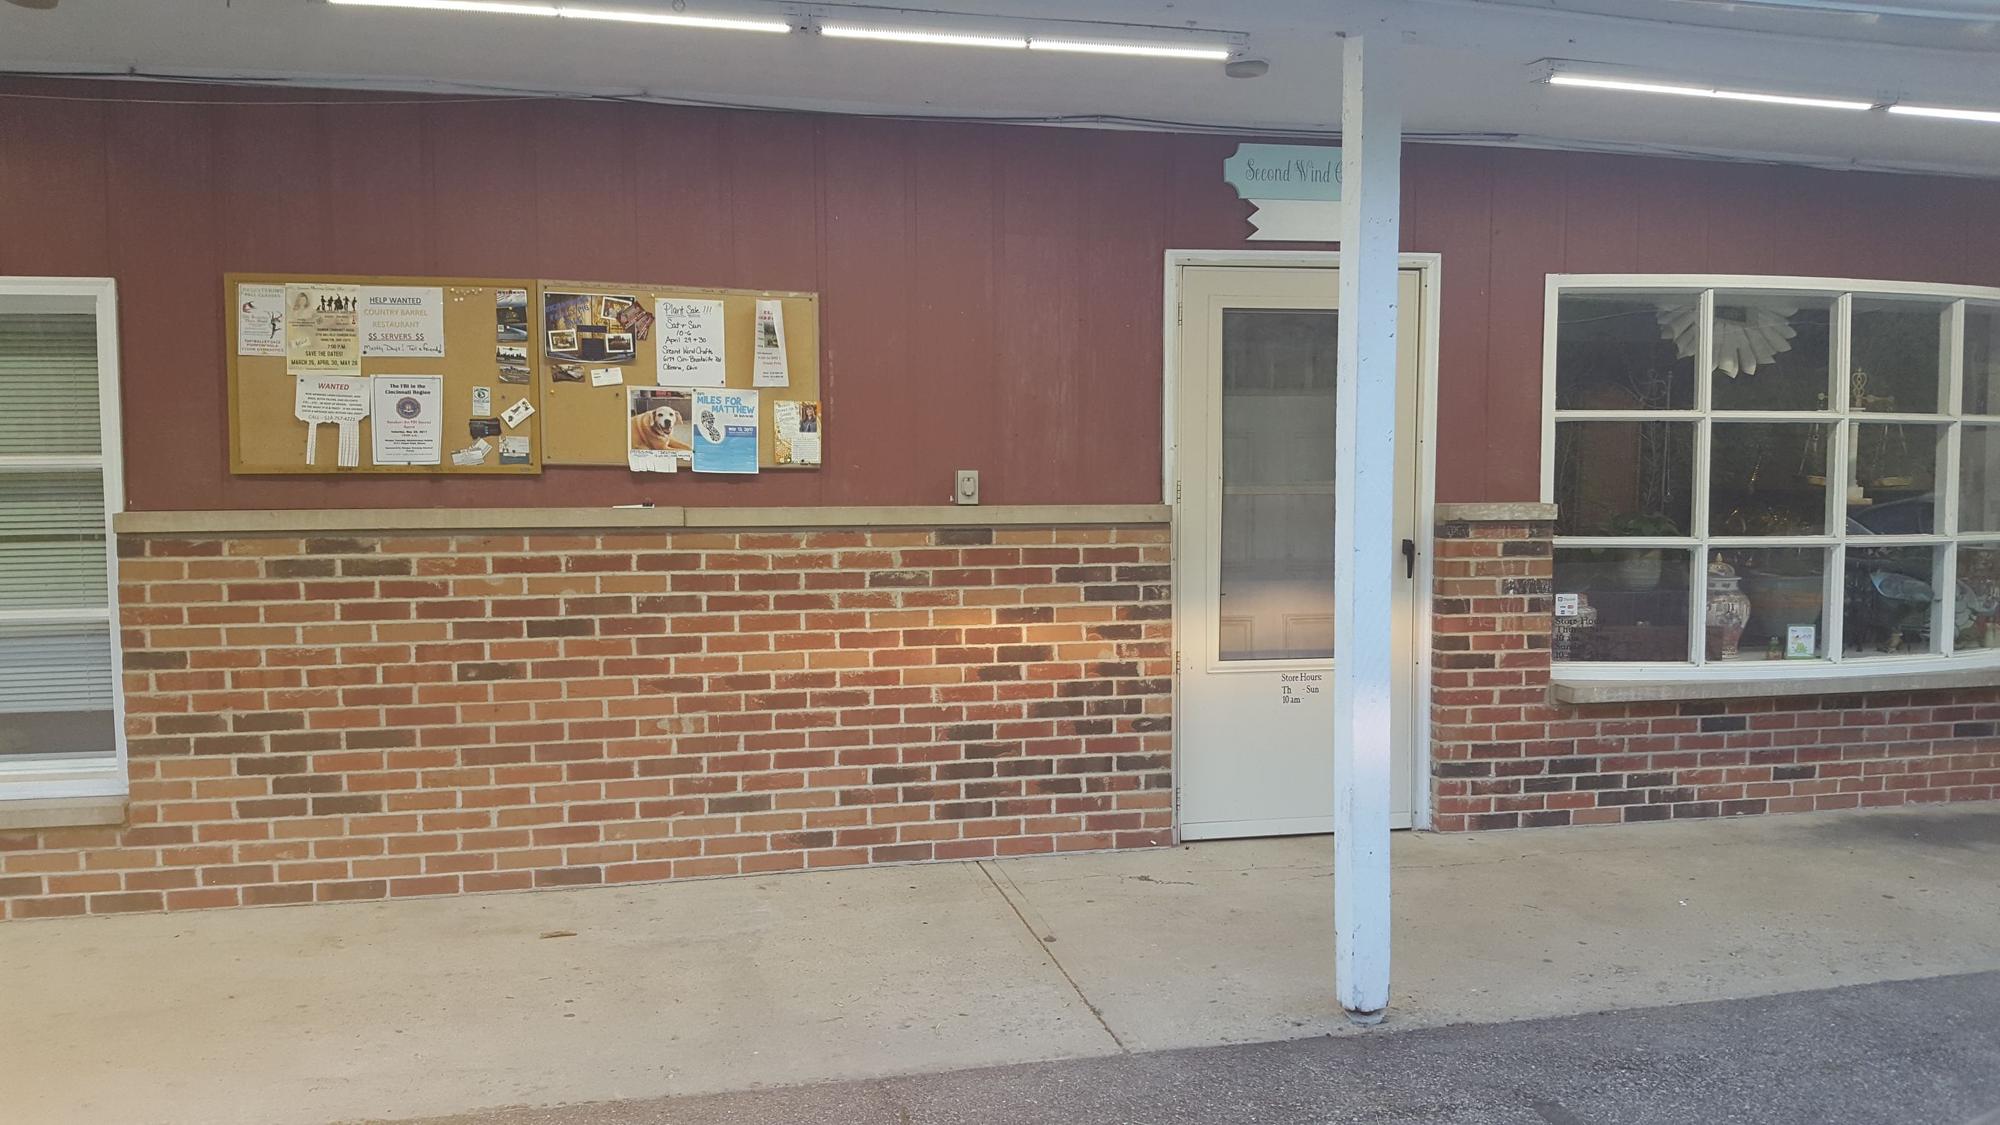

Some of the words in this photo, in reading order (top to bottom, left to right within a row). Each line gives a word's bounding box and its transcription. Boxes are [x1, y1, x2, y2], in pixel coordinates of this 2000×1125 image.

[1246, 158, 1291, 181] Second
[1296, 160, 1330, 183] Wind
[663, 302, 684, 314] Plant
[686, 305, 701, 314] Sale
[666, 319, 680, 329] Sat
[688, 320, 701, 329] Sun
[665, 336, 681, 344] April
[662, 345, 681, 354] Second
[697, 396, 721, 404] MILES
[725, 396, 742, 405] FOR
[712, 405, 755, 413] MATTHEW
[1281, 673, 1299, 682] Store
[1281, 685, 1292, 694] Th
[1306, 685, 1320, 693] Sun
